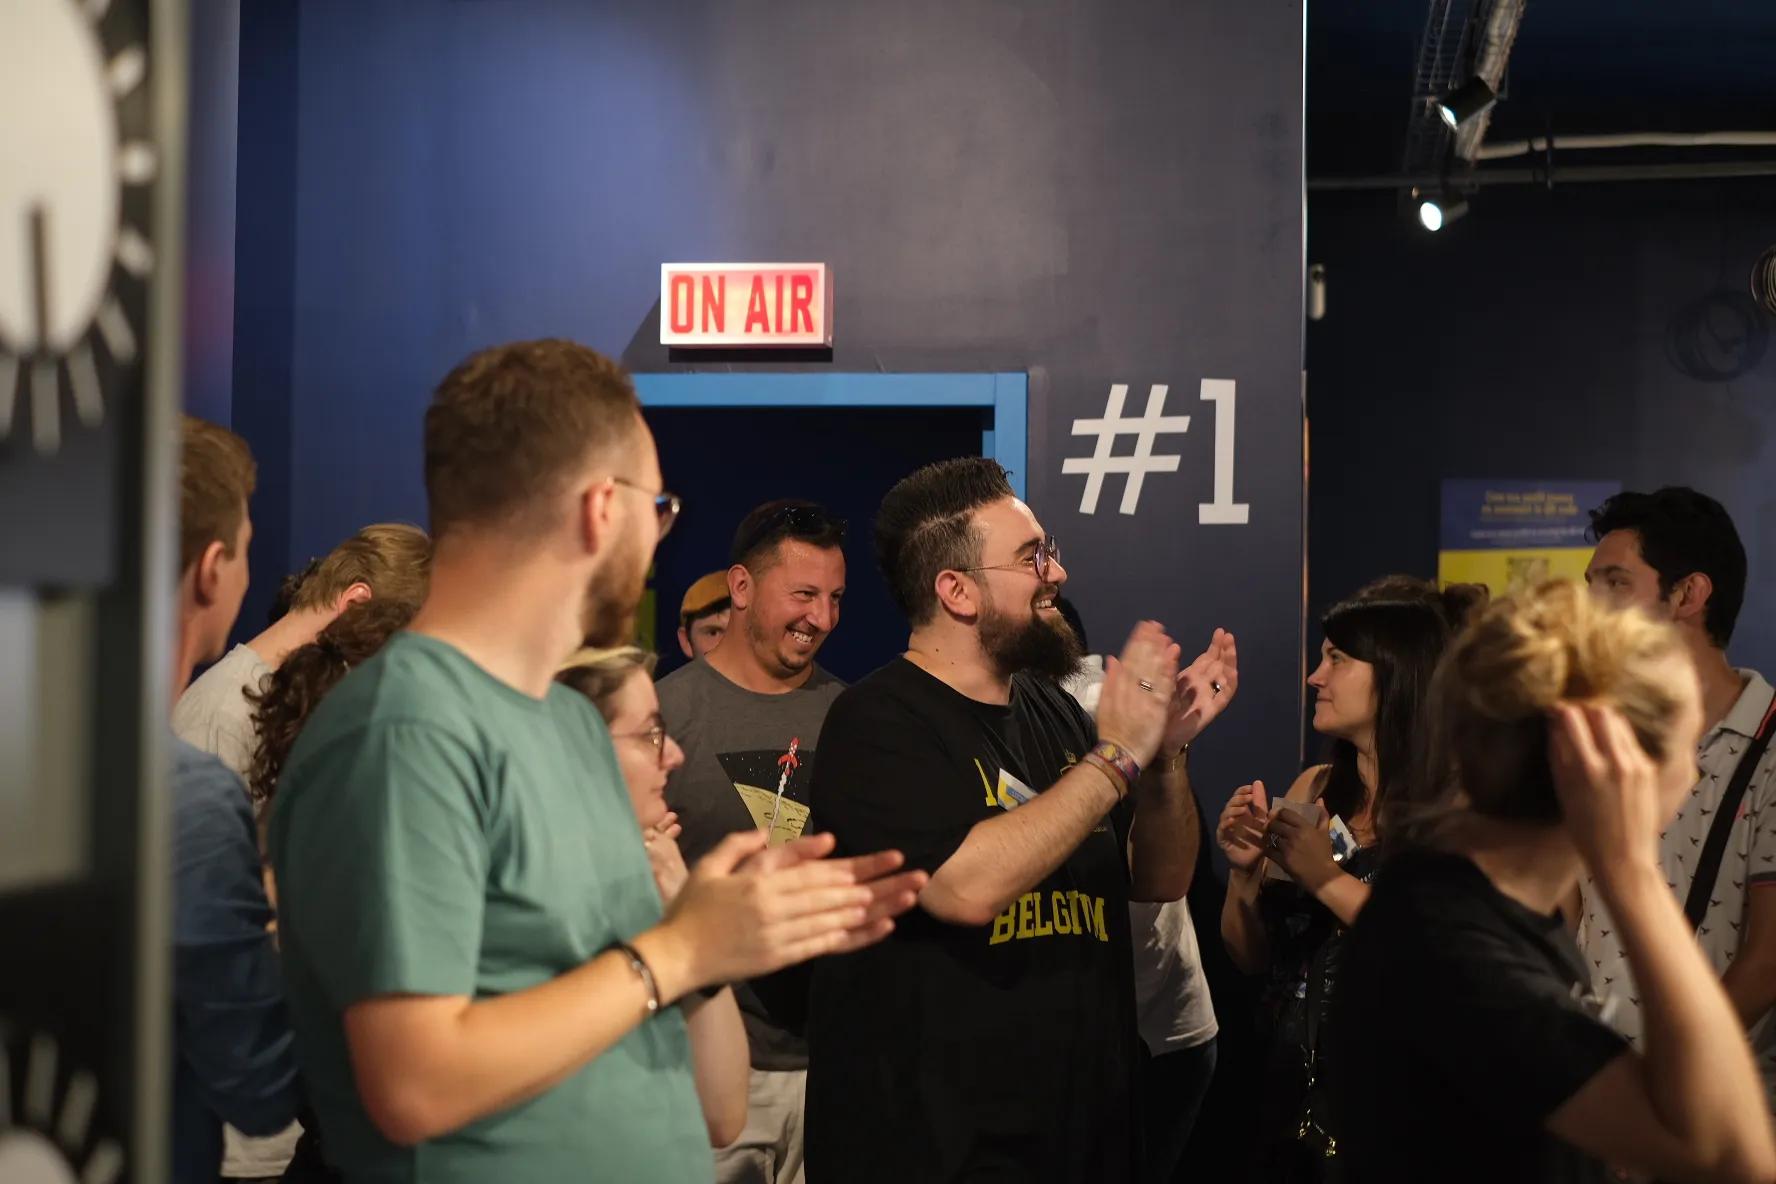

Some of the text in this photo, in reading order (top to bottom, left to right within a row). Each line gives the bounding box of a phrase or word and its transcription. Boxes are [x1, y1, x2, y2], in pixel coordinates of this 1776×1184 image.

[670, 274, 814, 334] ON AIR
[1061, 378, 1249, 524] #1
